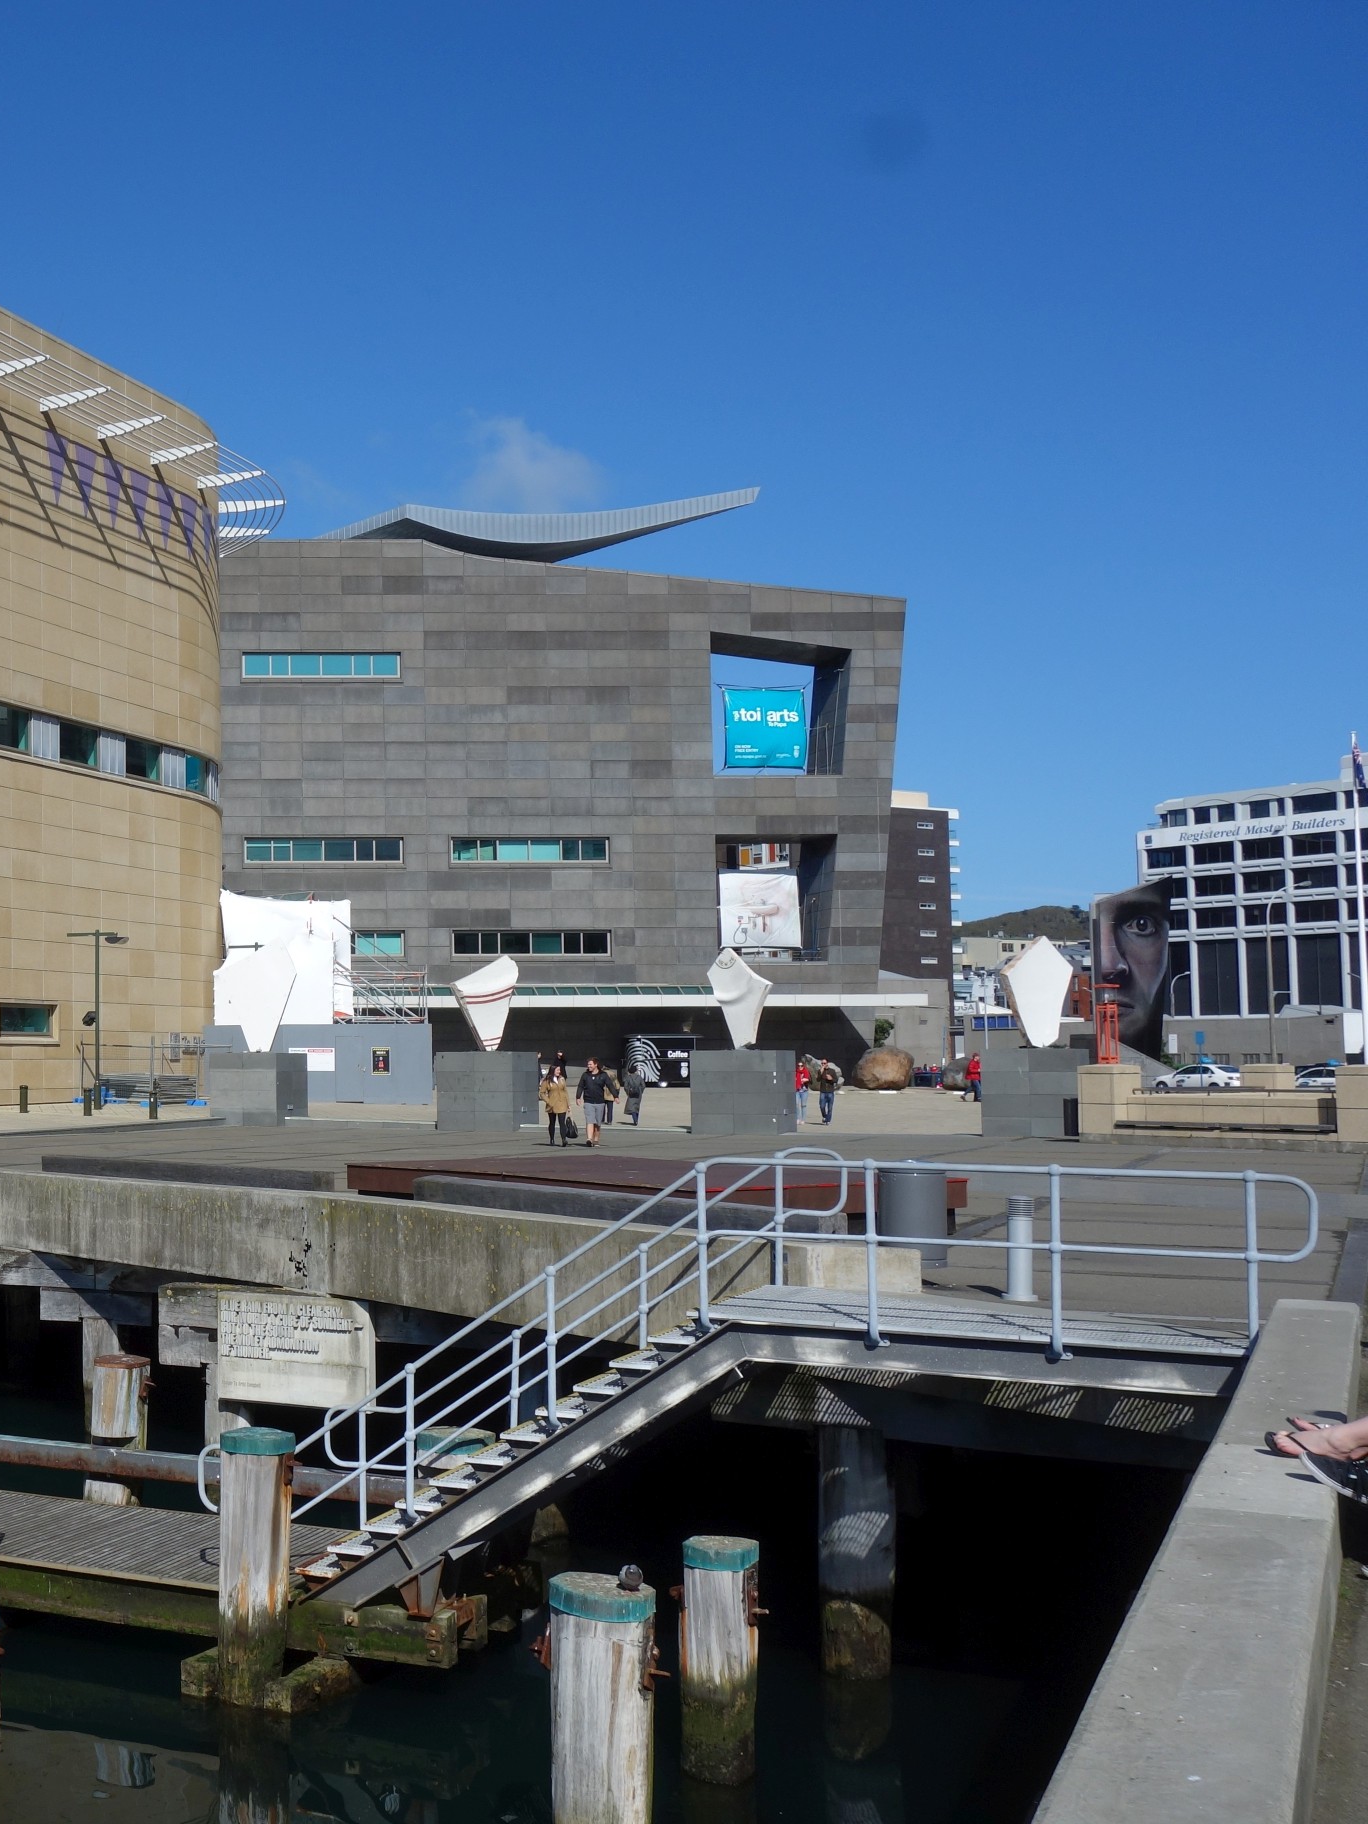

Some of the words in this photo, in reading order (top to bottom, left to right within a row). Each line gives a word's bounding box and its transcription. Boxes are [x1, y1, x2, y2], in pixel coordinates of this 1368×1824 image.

[739, 707, 761, 722] toi
[766, 709, 799, 722] arts
[1178, 825, 1240, 843] Registered
[1291, 816, 1346, 831] Builders
[667, 1050, 689, 1058] Coffee
[220, 1299, 241, 1312] BLUE
[241, 1300, 262, 1314] RAIN
[263, 1301, 288, 1316] FROM
[289, 1303, 296, 1316] A
[297, 1304, 323, 1318] CLEAR
[267, 1325, 296, 1339] SOUTH
[312, 1316, 353, 1333] SUNLIGHT
[236, 1334, 266, 1348] VIOLET
[264, 1336, 320, 1354] ADMONITION
